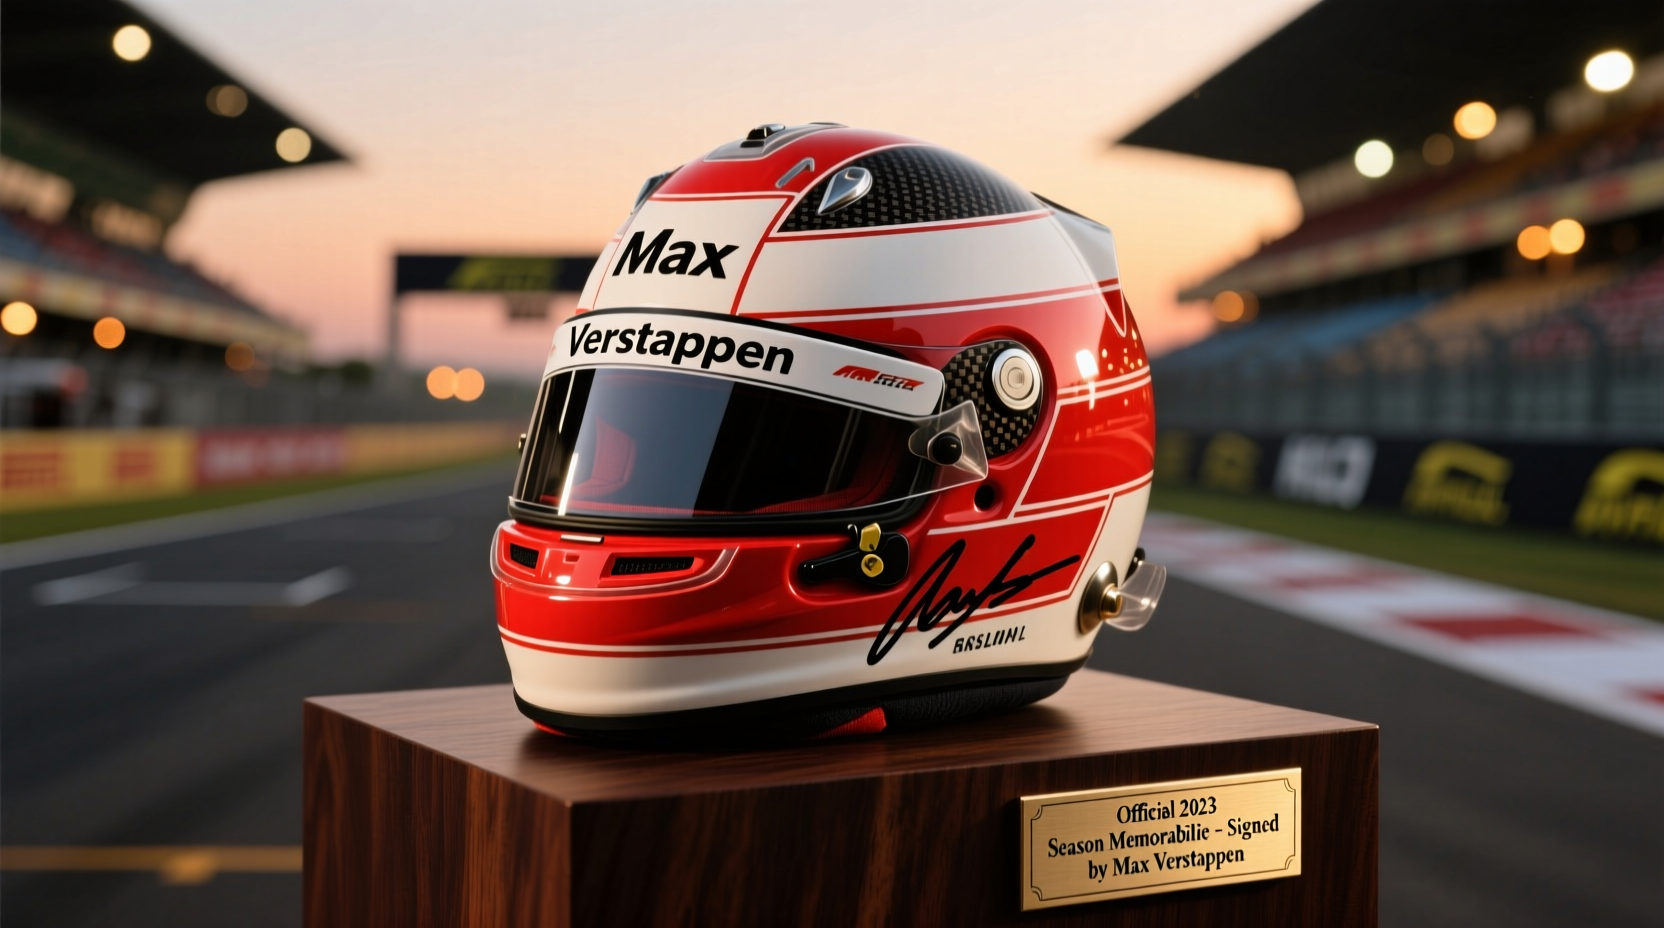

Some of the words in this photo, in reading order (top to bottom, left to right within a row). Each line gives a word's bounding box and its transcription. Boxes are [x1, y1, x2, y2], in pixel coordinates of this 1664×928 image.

[612, 228, 740, 280] Max
[569, 322, 795, 375] Verstappen
[1117, 800, 1175, 824] Official
[1179, 796, 1217, 817] 2023
[1048, 837, 1104, 857] Season
[1109, 823, 1210, 850] Memorabilie
[1227, 813, 1279, 840] Signed
[1088, 860, 1108, 883] by
[1112, 856, 1150, 876] Max
[1153, 849, 1245, 871] Verstappen
